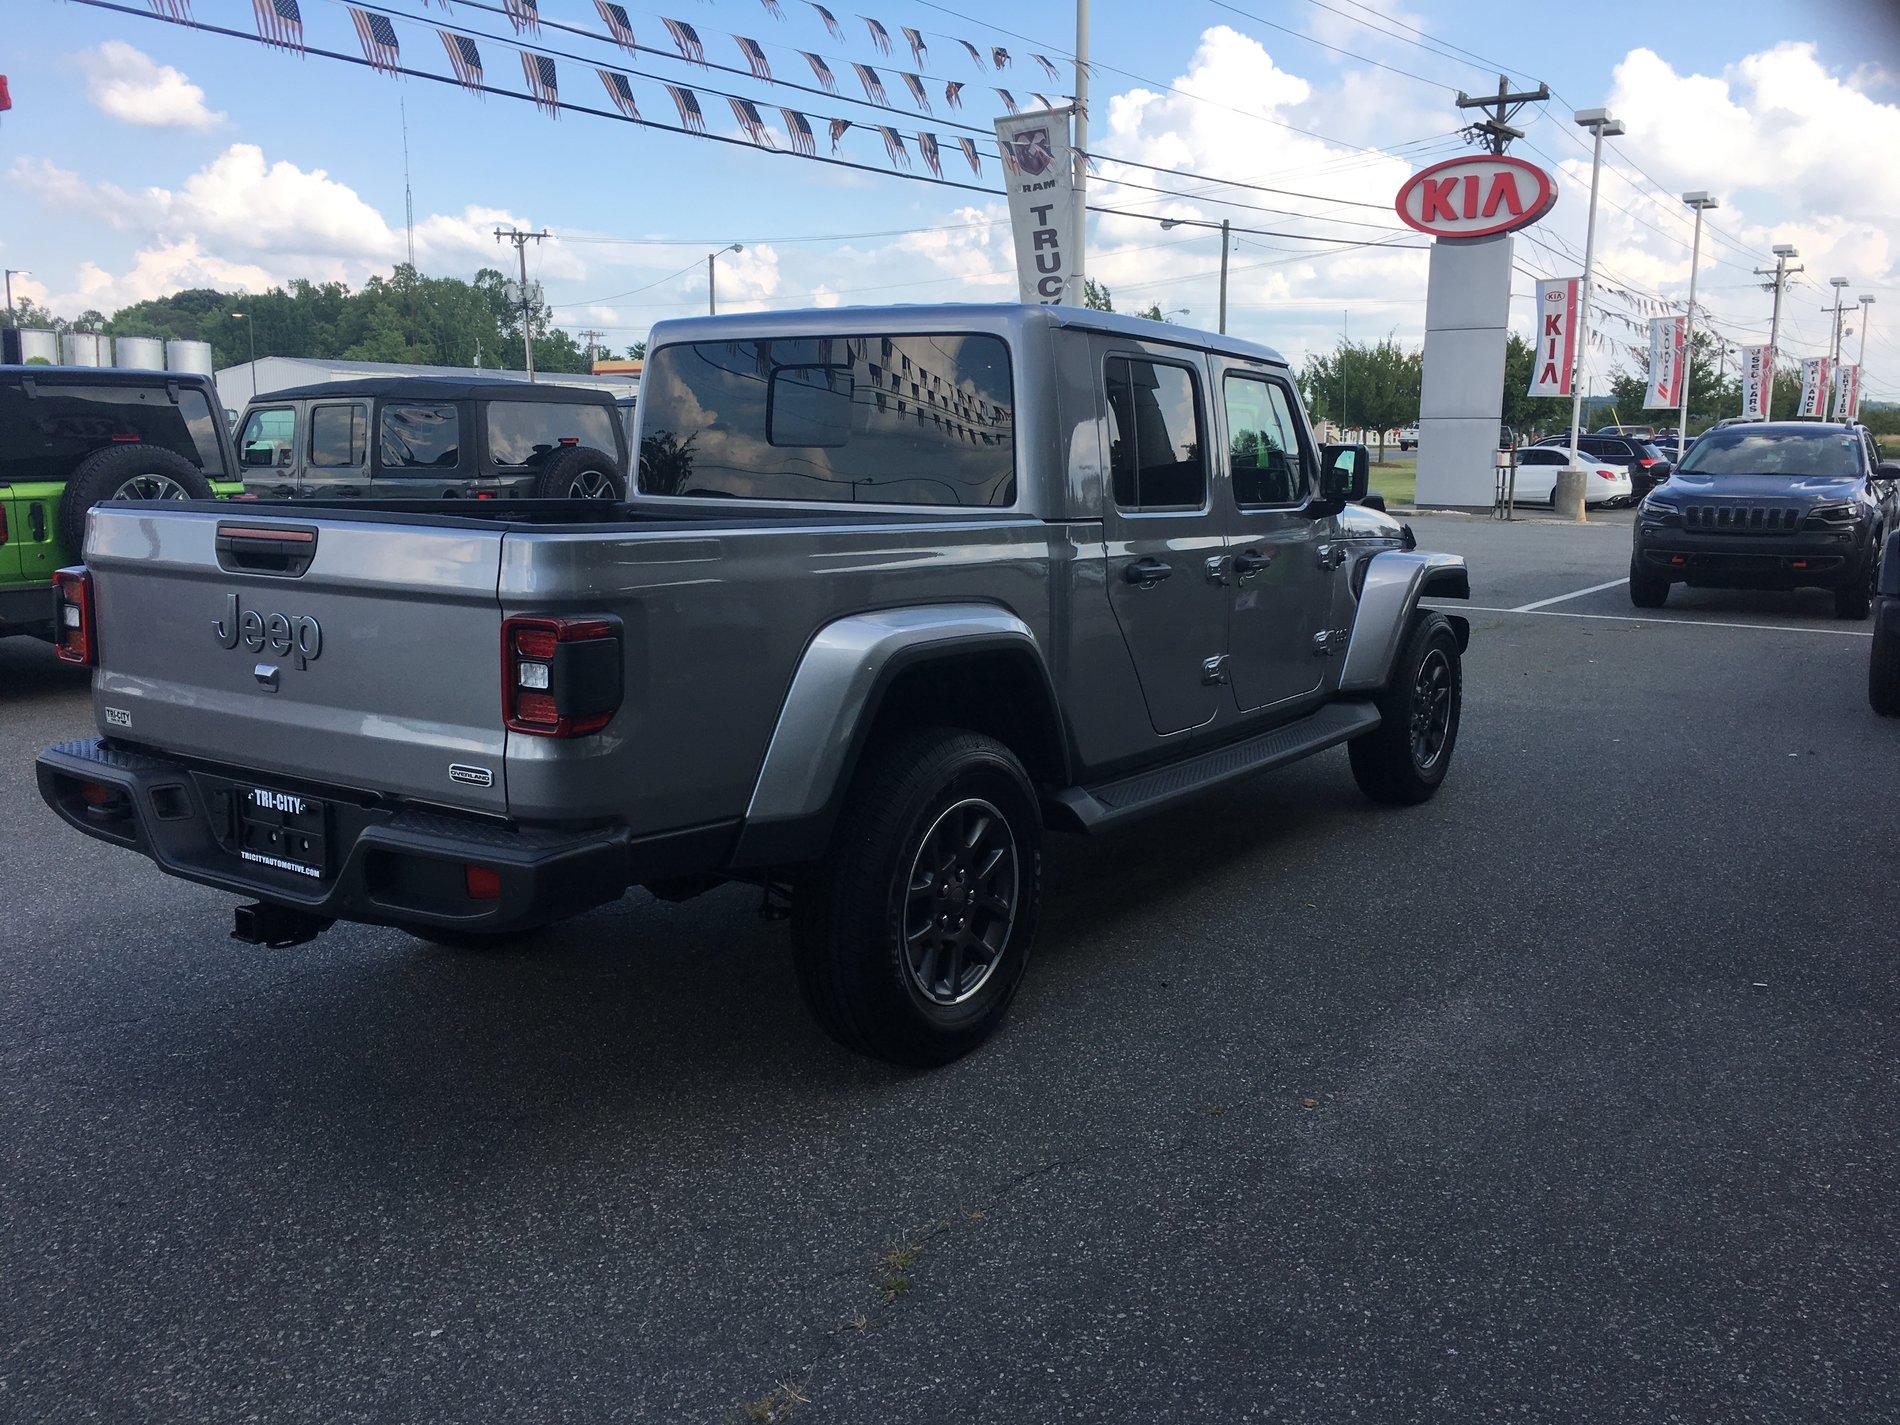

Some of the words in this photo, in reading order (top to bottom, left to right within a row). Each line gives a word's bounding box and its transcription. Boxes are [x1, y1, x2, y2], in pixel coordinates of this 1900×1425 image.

[1022, 179, 1055, 193] RAM
[1421, 171, 1523, 222] KIA
[1030, 204, 1063, 305] TRUC
[1540, 314, 1562, 384] KIA
[1749, 383, 1757, 412] CARS
[211, 593, 322, 671] Jeep
[254, 789, 301, 814] TRI-CITY
[241, 851, 320, 878] TRICITYAUTOMOTIVE.COM
